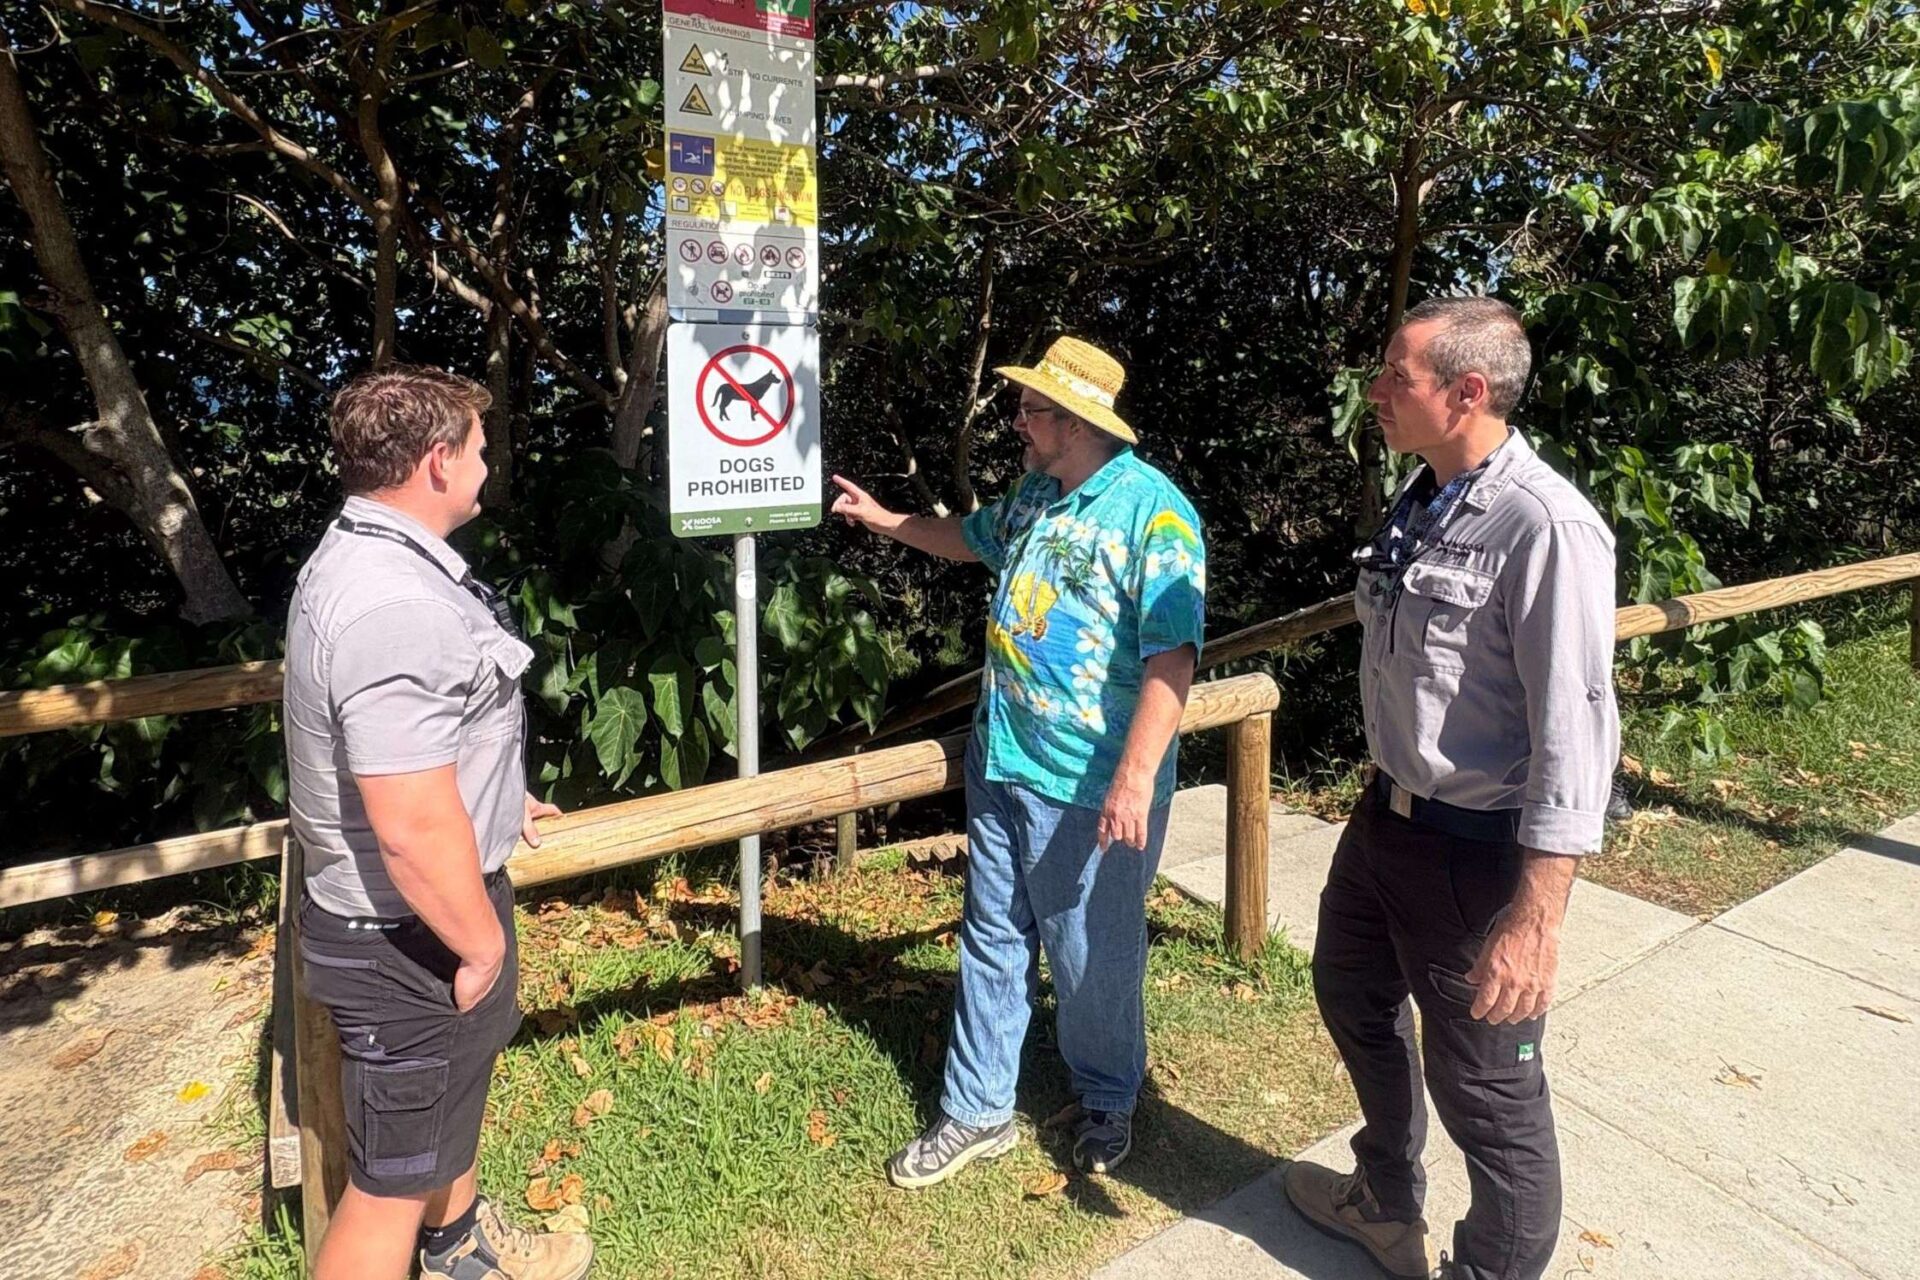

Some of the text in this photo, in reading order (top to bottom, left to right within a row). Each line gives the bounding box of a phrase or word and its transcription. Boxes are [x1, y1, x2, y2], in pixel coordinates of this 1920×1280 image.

[708, 25, 752, 39] WARNINGS
[728, 68, 804, 88] STRNG CURRENTS
[720, 457, 775, 474] DOGS
[688, 476, 805, 497] PROHIBITED
[693, 516, 722, 526] NOOSA
